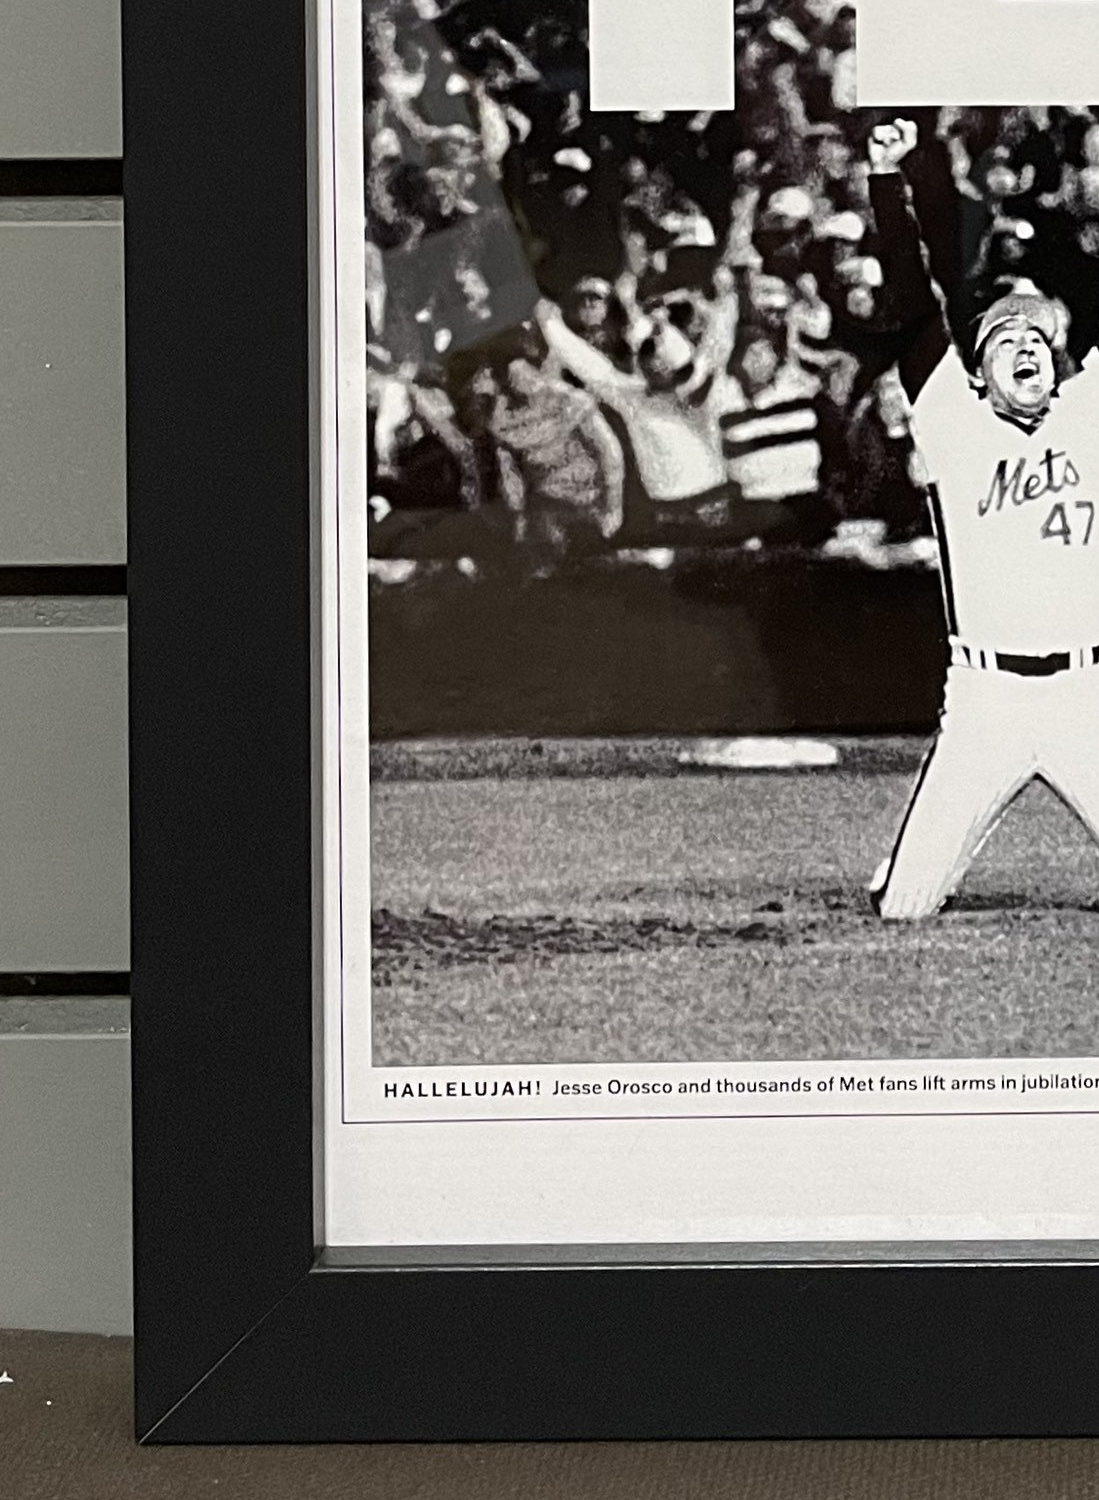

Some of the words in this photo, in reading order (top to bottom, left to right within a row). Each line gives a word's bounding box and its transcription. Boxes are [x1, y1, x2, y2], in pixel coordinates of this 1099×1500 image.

[978, 447, 1080, 517] Mets
[1040, 500, 1095, 546] 47
[385, 1082, 541, 1098] HALLELUJAH!
[553, 1080, 602, 1096] Jesse
[608, 1079, 673, 1095] Orosco
[679, 1078, 711, 1094] and
[717, 1077, 812, 1094] thousands
[817, 1076, 835, 1092] of
[840, 1076, 874, 1092] Met
[880, 1075, 918, 1091] fans
[923, 1074, 946, 1091] lift
[952, 1078, 996, 1091] arms
[1001, 1074, 1017, 1090] in
